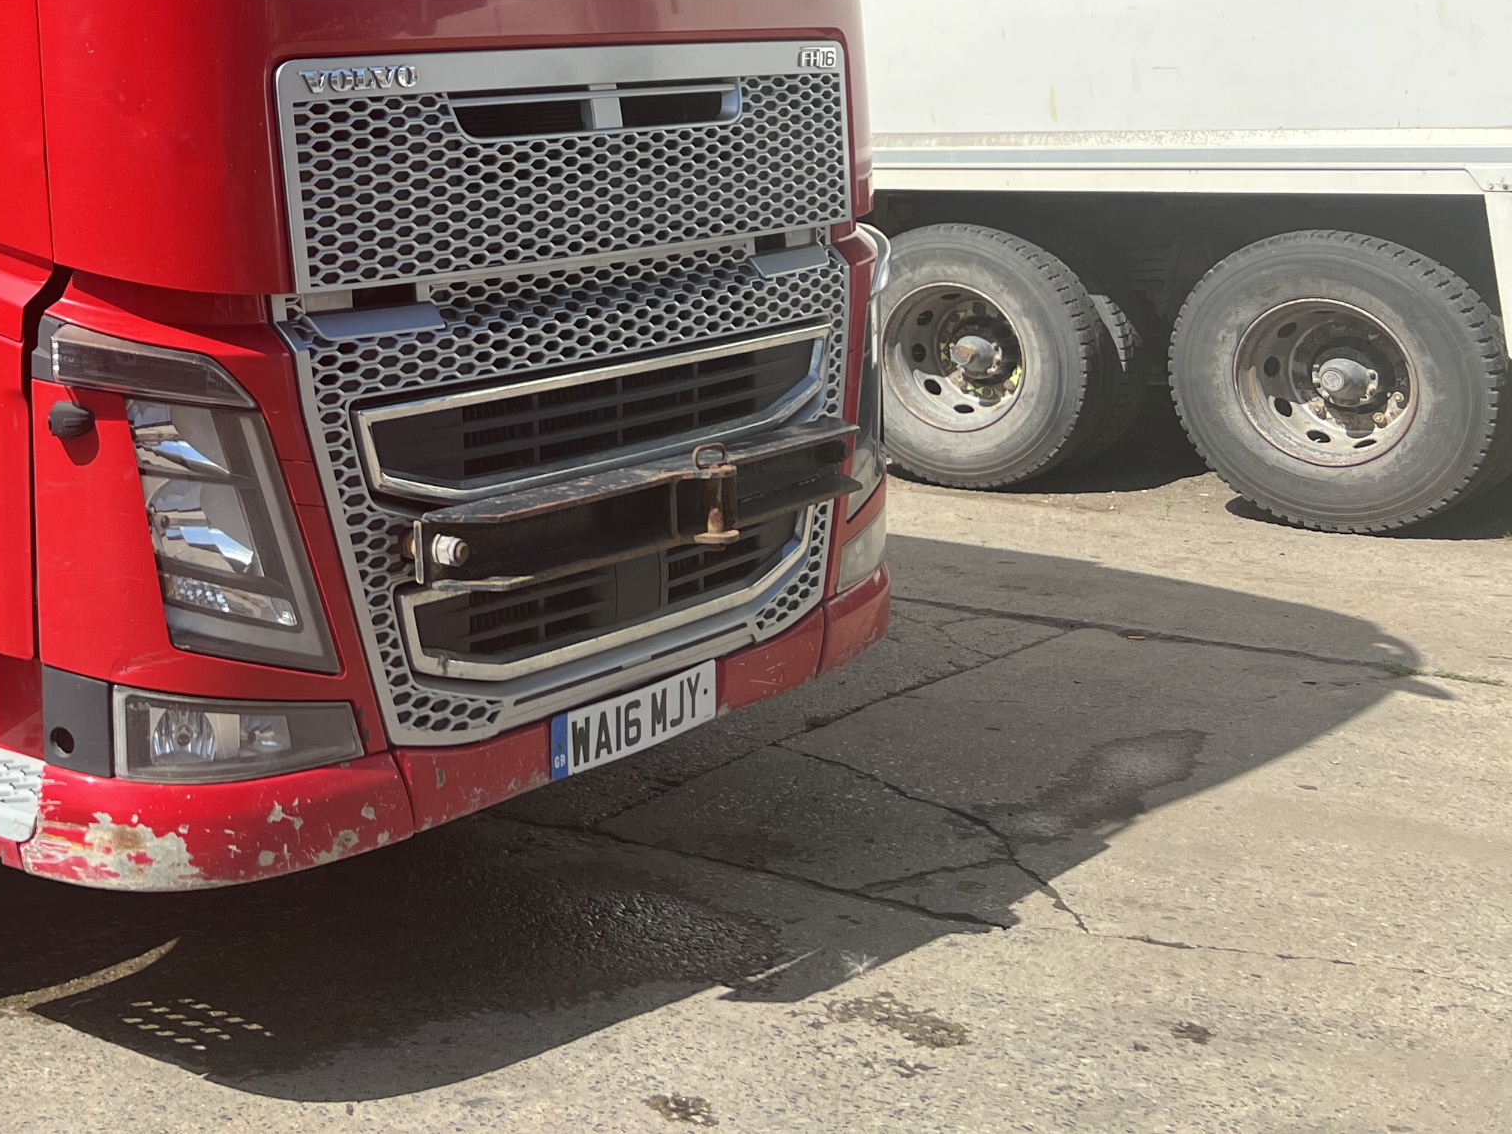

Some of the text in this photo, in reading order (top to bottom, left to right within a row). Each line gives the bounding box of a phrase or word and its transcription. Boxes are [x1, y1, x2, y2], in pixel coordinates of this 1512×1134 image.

[798, 47, 837, 69] FH16
[298, 64, 419, 94] VOLVO
[571, 672, 701, 767] WA16 MJY
[554, 754, 567, 769] GB
